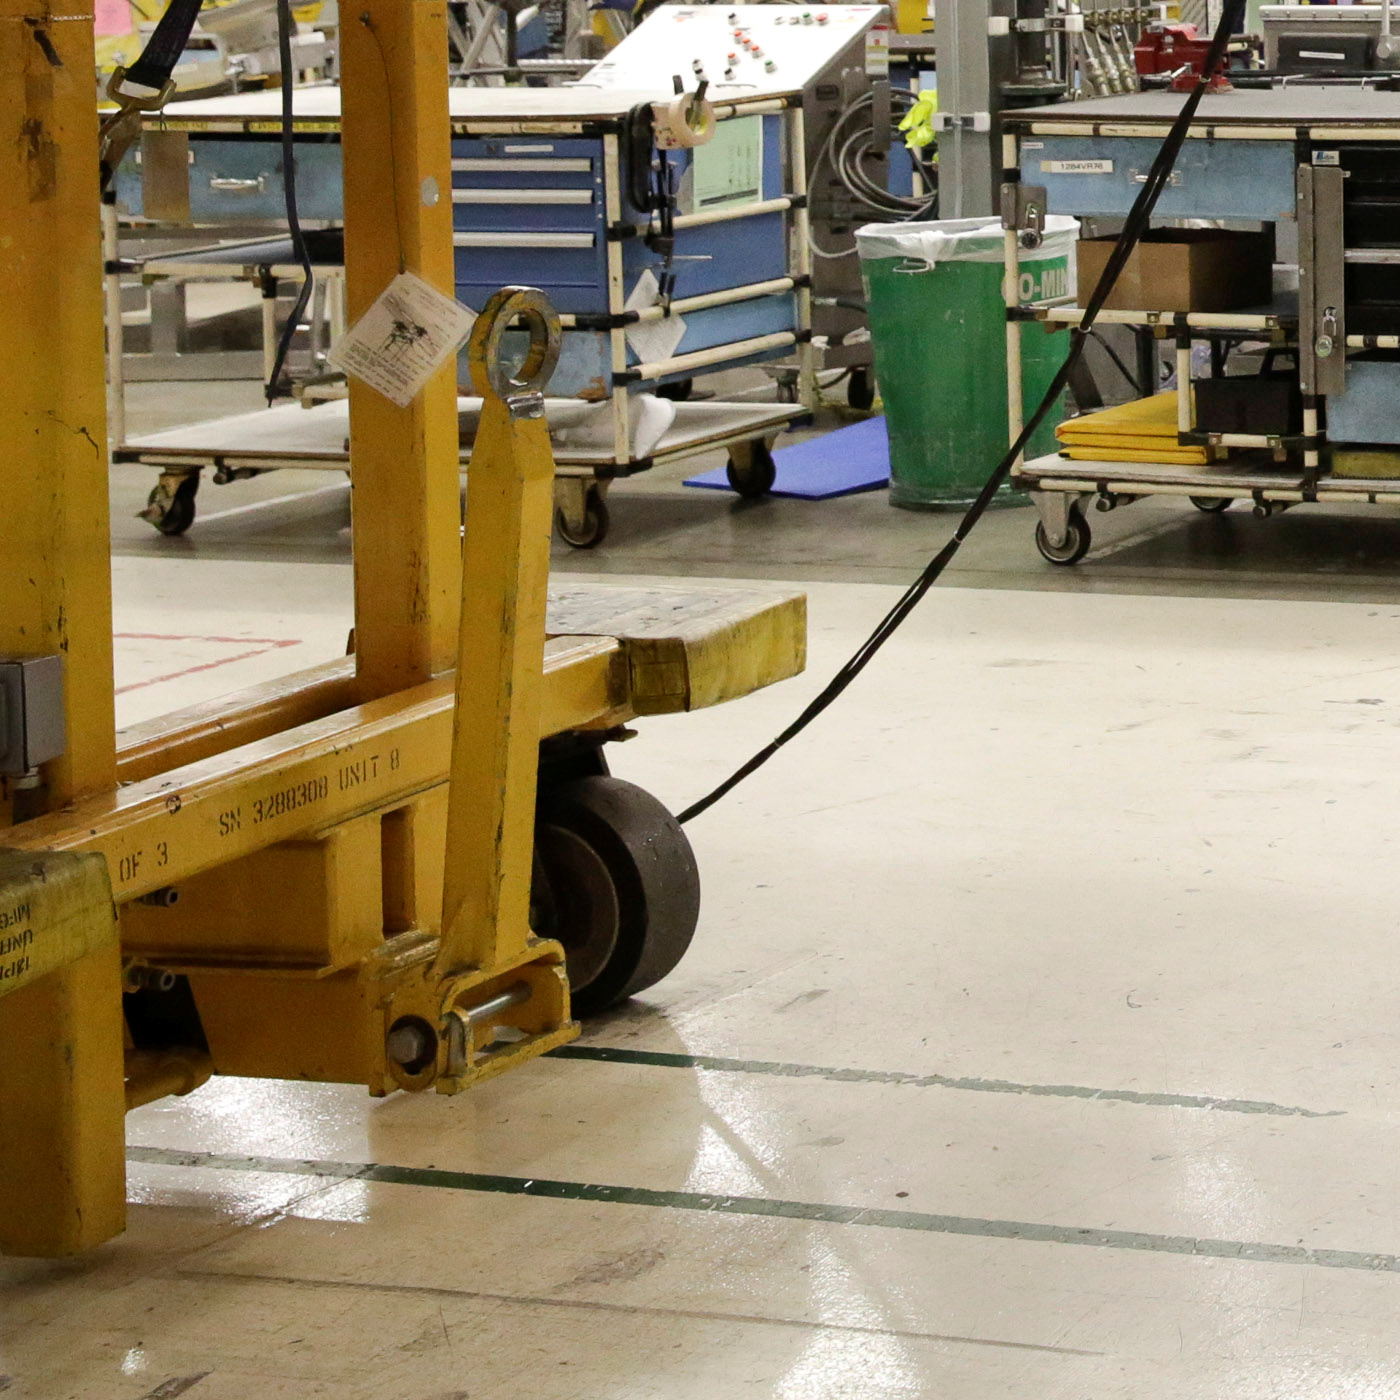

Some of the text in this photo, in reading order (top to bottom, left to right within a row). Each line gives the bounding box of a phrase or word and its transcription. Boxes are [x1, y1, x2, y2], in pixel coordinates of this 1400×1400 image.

[119, 850, 142, 882] OF
[157, 842, 168, 867] 3
[339, 755, 379, 791] UNIT
[390, 748, 400, 771] 8
